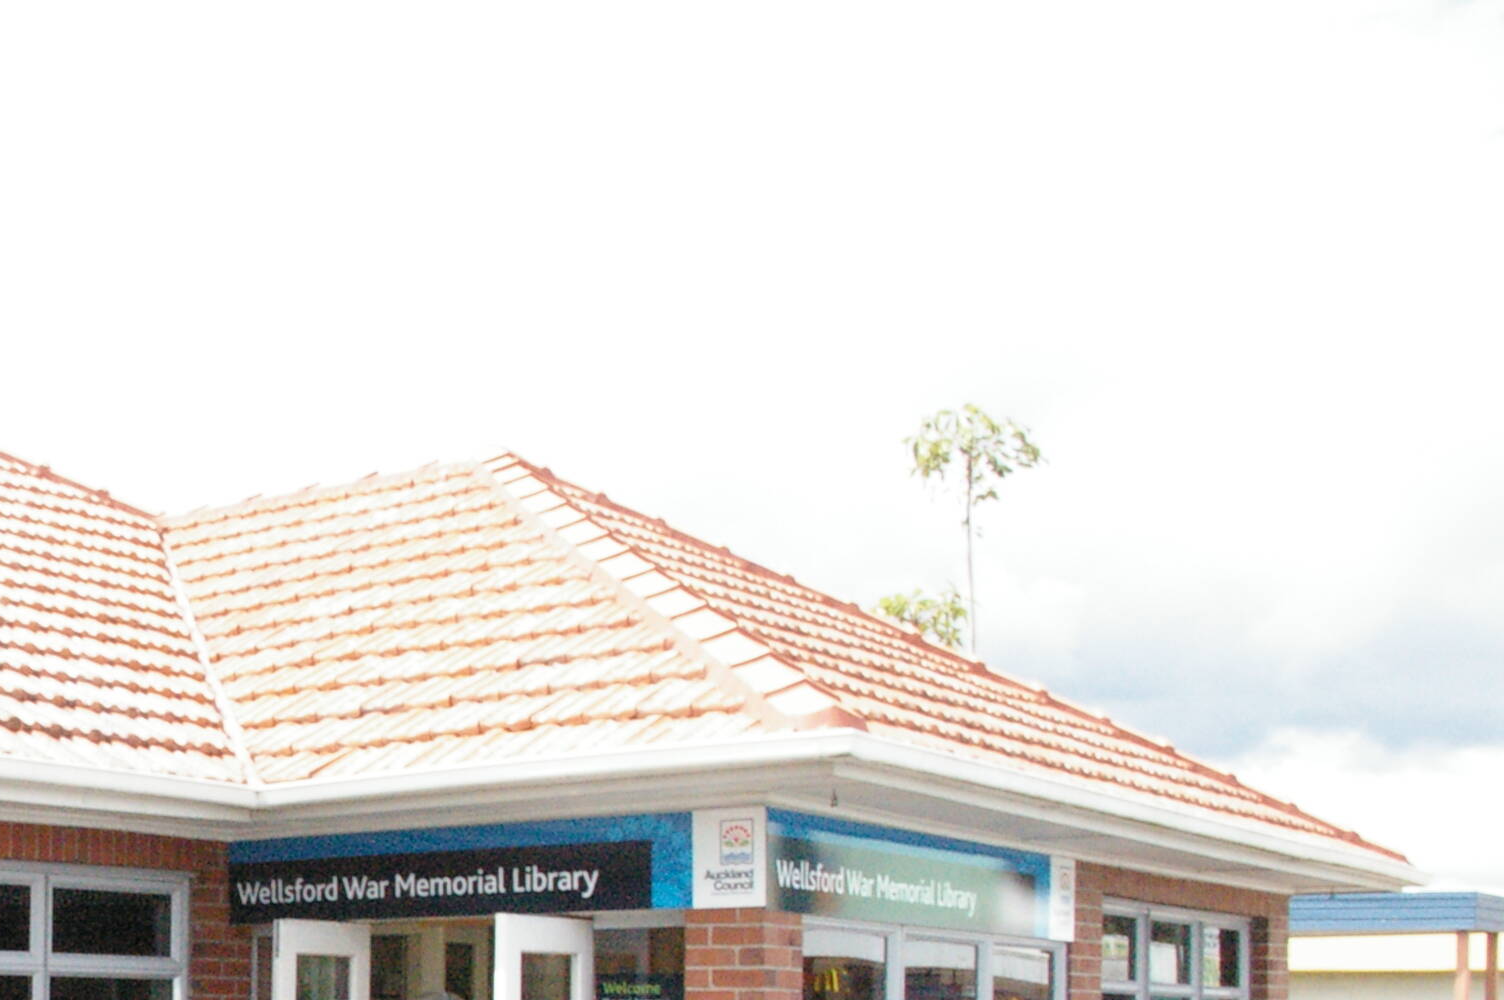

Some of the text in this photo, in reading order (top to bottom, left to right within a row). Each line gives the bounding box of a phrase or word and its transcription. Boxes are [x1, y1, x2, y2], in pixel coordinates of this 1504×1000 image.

[236, 864, 599, 906] Wellsford War Memorial Library
[775, 860, 977, 918] Wellsford War Memorial Library
